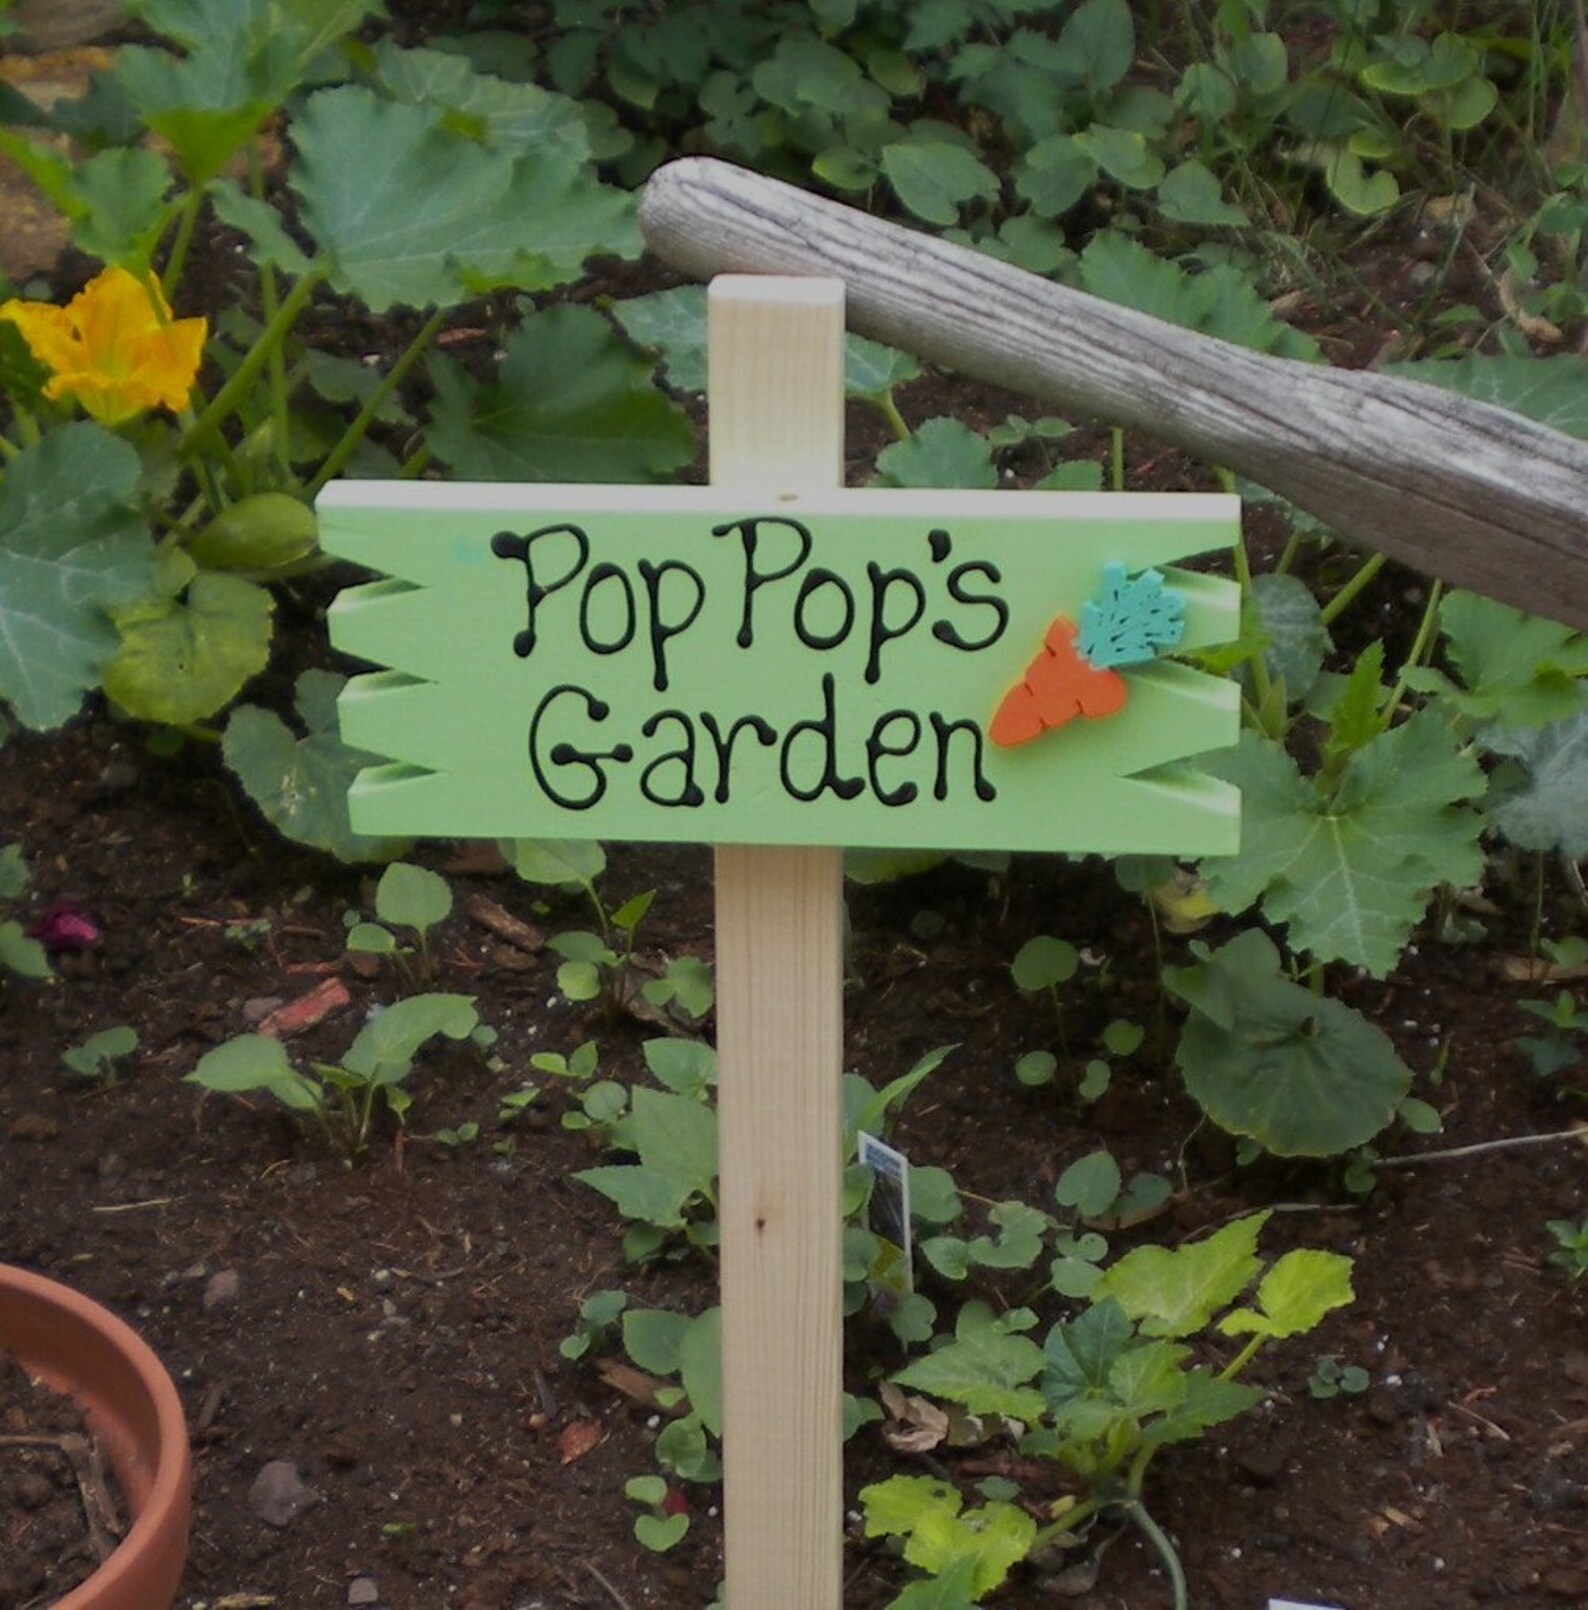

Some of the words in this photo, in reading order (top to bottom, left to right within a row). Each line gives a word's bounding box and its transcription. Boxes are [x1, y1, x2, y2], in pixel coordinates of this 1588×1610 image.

[490, 522, 706, 692] Pop
[712, 516, 1010, 686] Pop's
[528, 673, 998, 812] Garden
